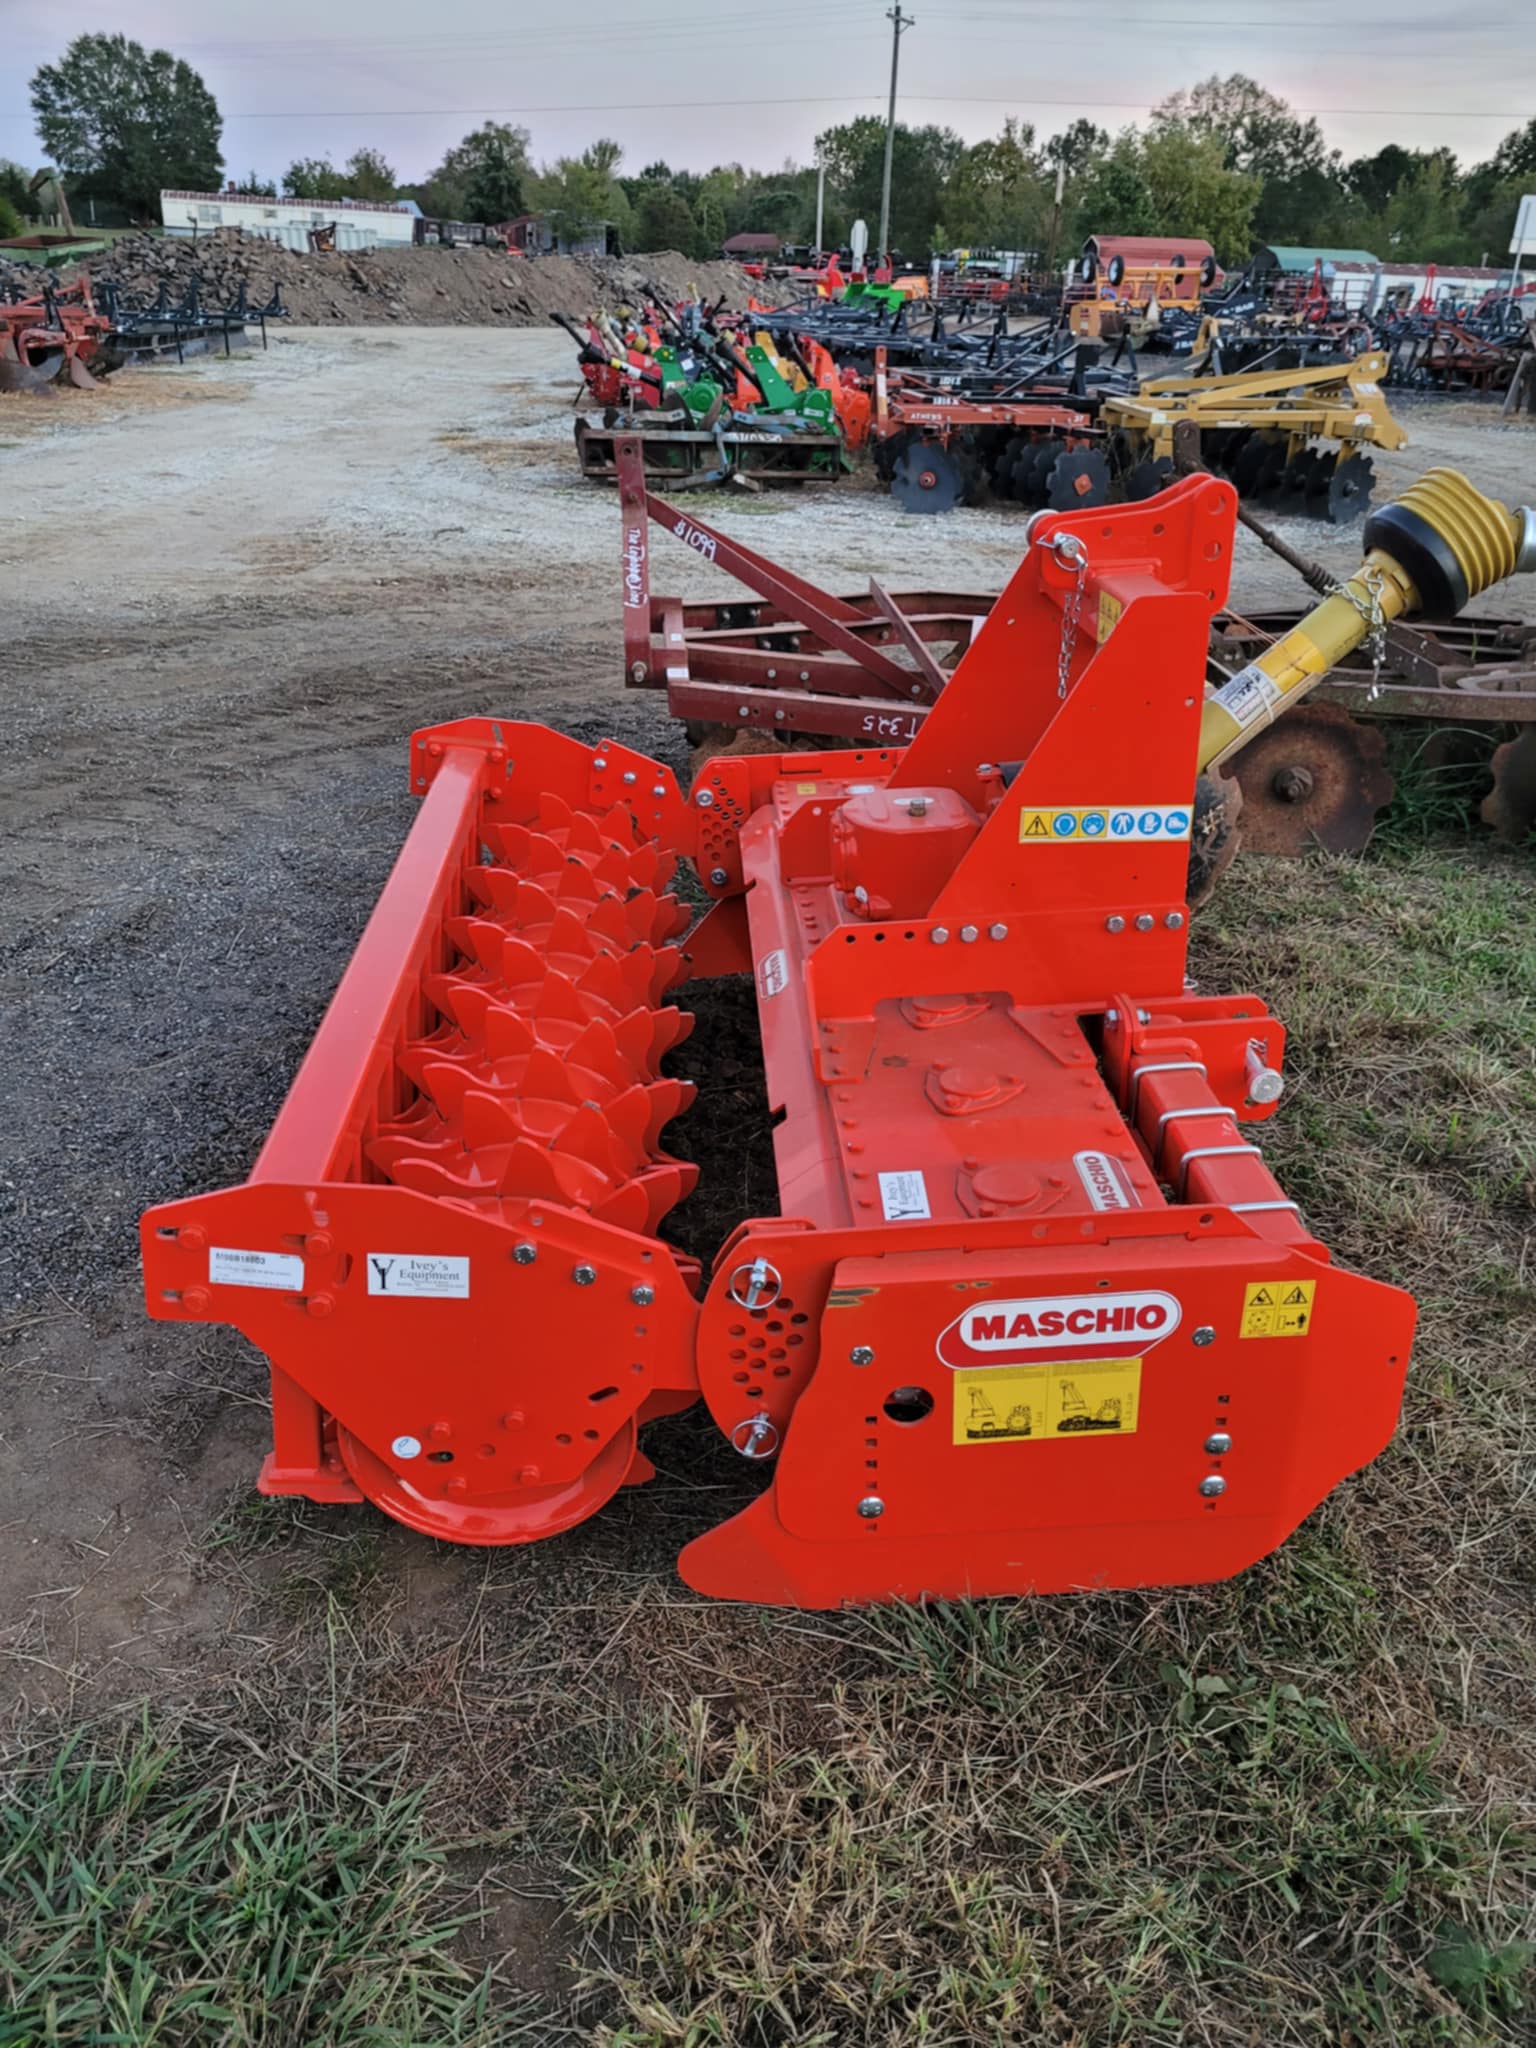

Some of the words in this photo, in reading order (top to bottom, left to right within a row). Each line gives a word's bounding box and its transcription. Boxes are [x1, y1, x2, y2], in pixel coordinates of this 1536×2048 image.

[410, 1259, 449, 1272] Ivey's
[399, 1268, 461, 1281] Equipment
[971, 1304, 1167, 1341] MASCHIO
